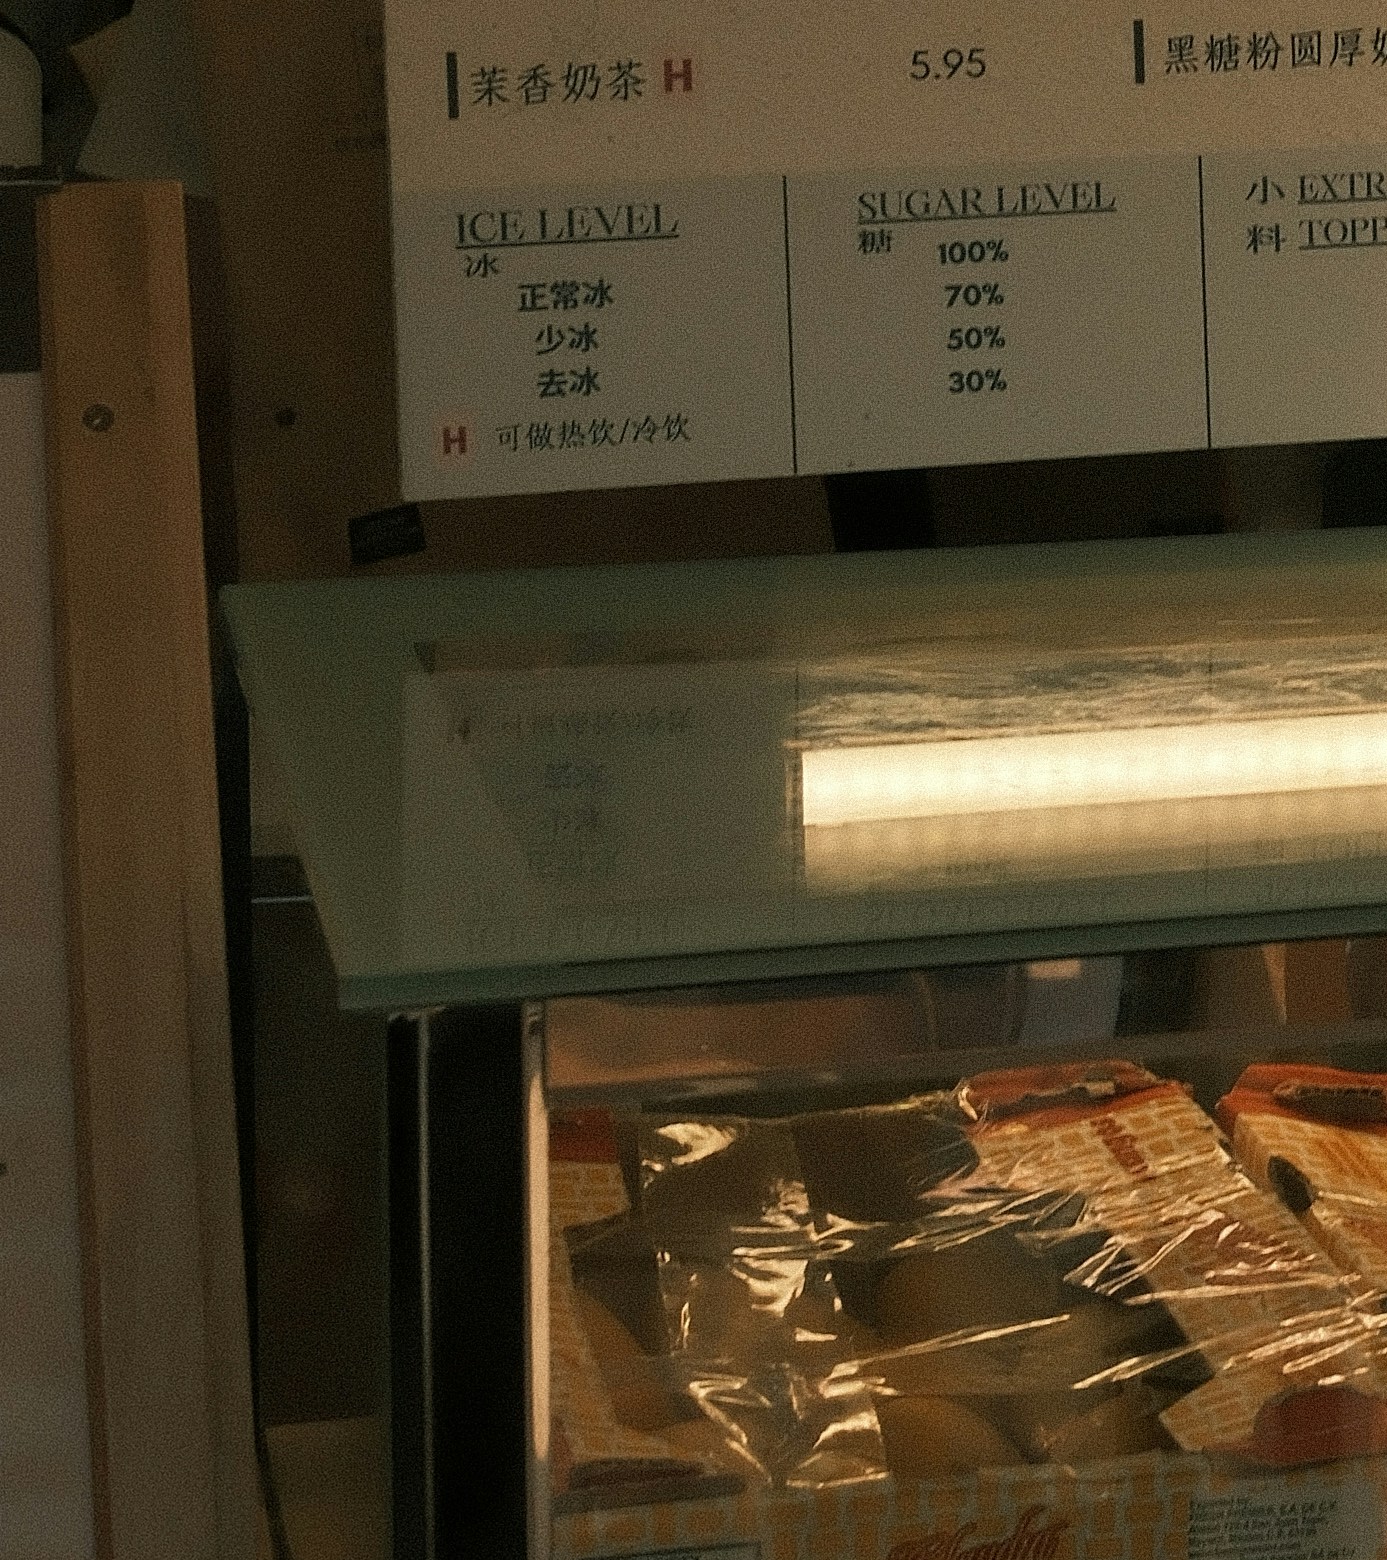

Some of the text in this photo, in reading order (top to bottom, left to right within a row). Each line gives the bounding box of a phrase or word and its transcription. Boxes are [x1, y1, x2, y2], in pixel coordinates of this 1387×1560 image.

[472, 47, 986, 106] 茉香奶茶 H 5.95
[858, 181, 1116, 223] SUGAR LEVEL
[455, 203, 679, 248] ICE LEVEL
[461, 251, 500, 279] 冰
[938, 239, 1009, 265] 100%
[945, 283, 1004, 308] 70%
[947, 326, 1006, 351] 50%
[537, 366, 600, 398] 去冰
[949, 369, 1007, 394] 30%
[443, 426, 467, 455] H
